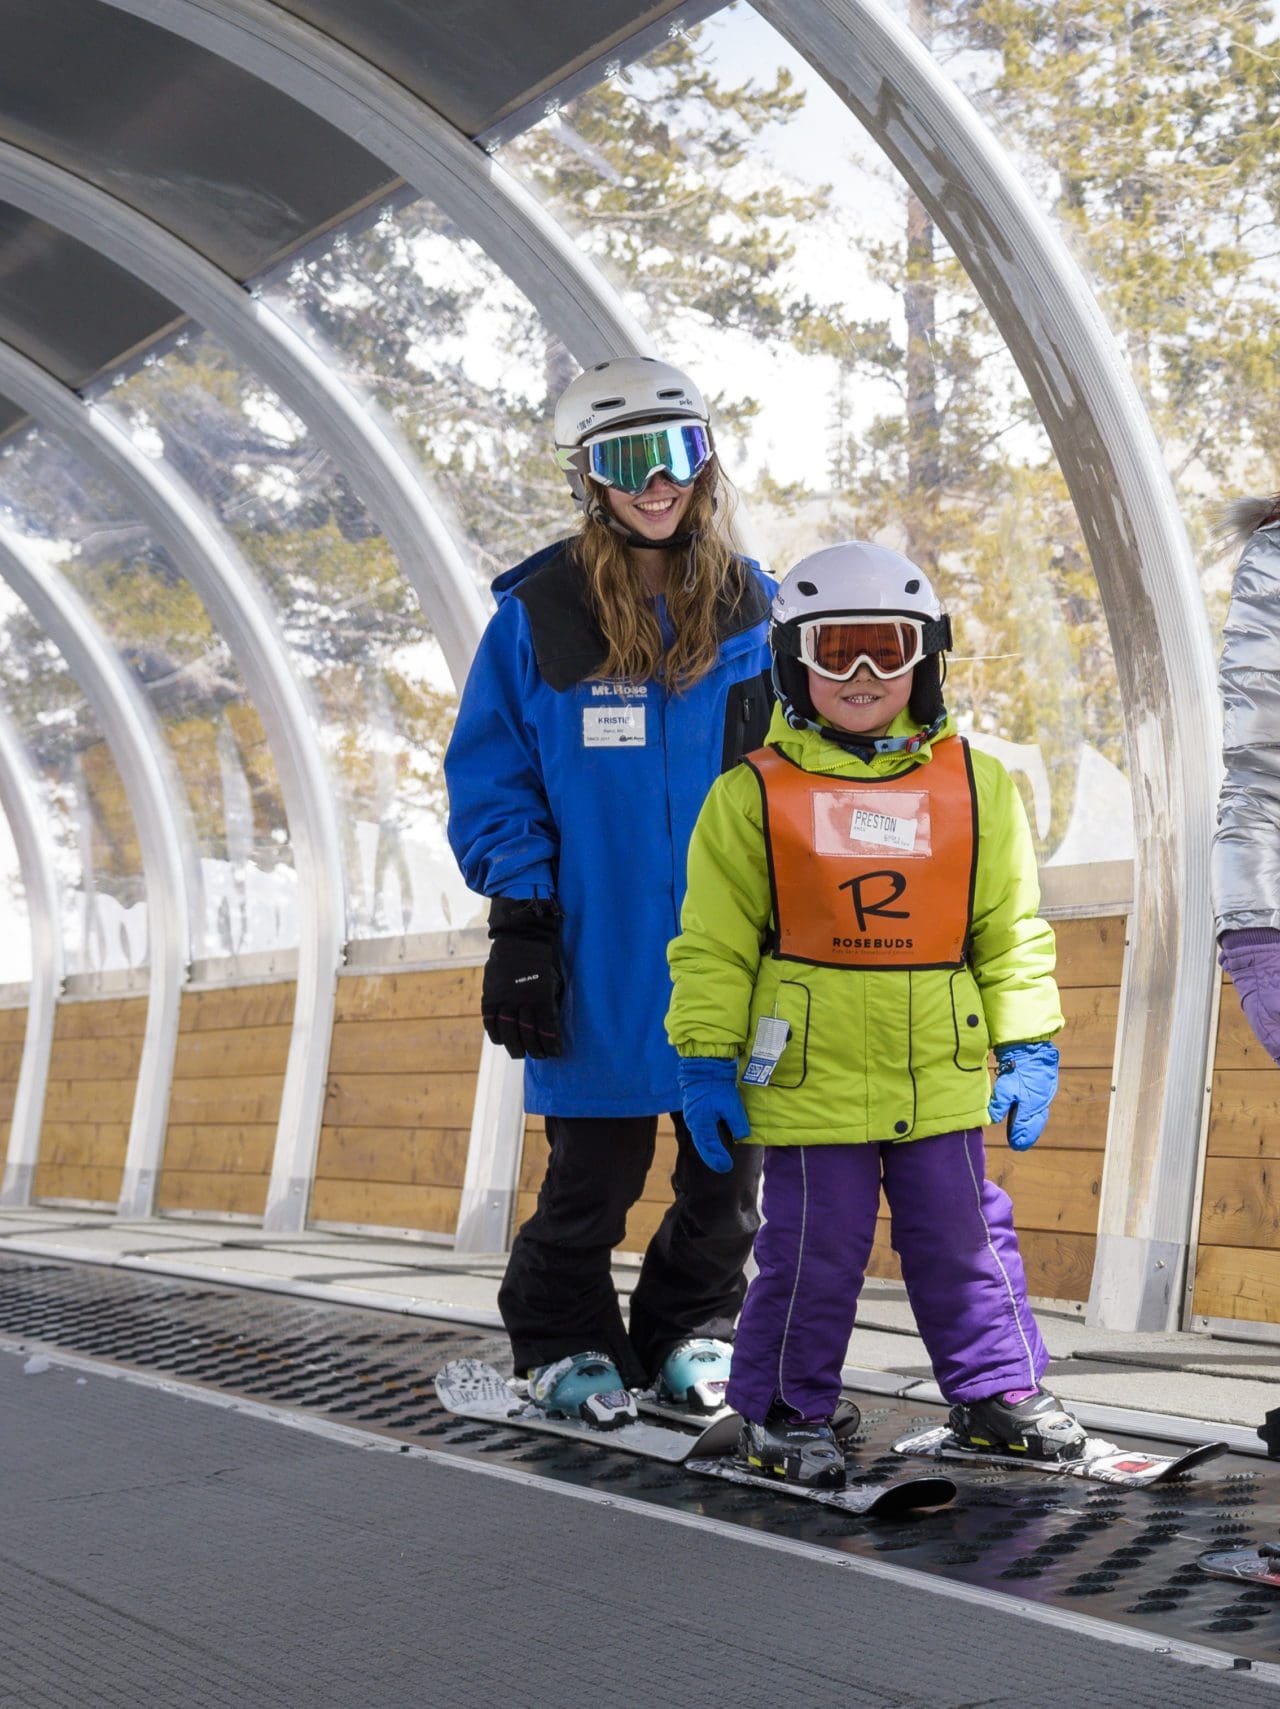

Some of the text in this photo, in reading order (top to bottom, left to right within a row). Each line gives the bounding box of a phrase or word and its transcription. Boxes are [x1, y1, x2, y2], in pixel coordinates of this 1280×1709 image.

[613, 685, 647, 695] Rose
[855, 811, 897, 832] PRESTON
[838, 870, 911, 932] R
[833, 938, 913, 948] ROSEBUDS
